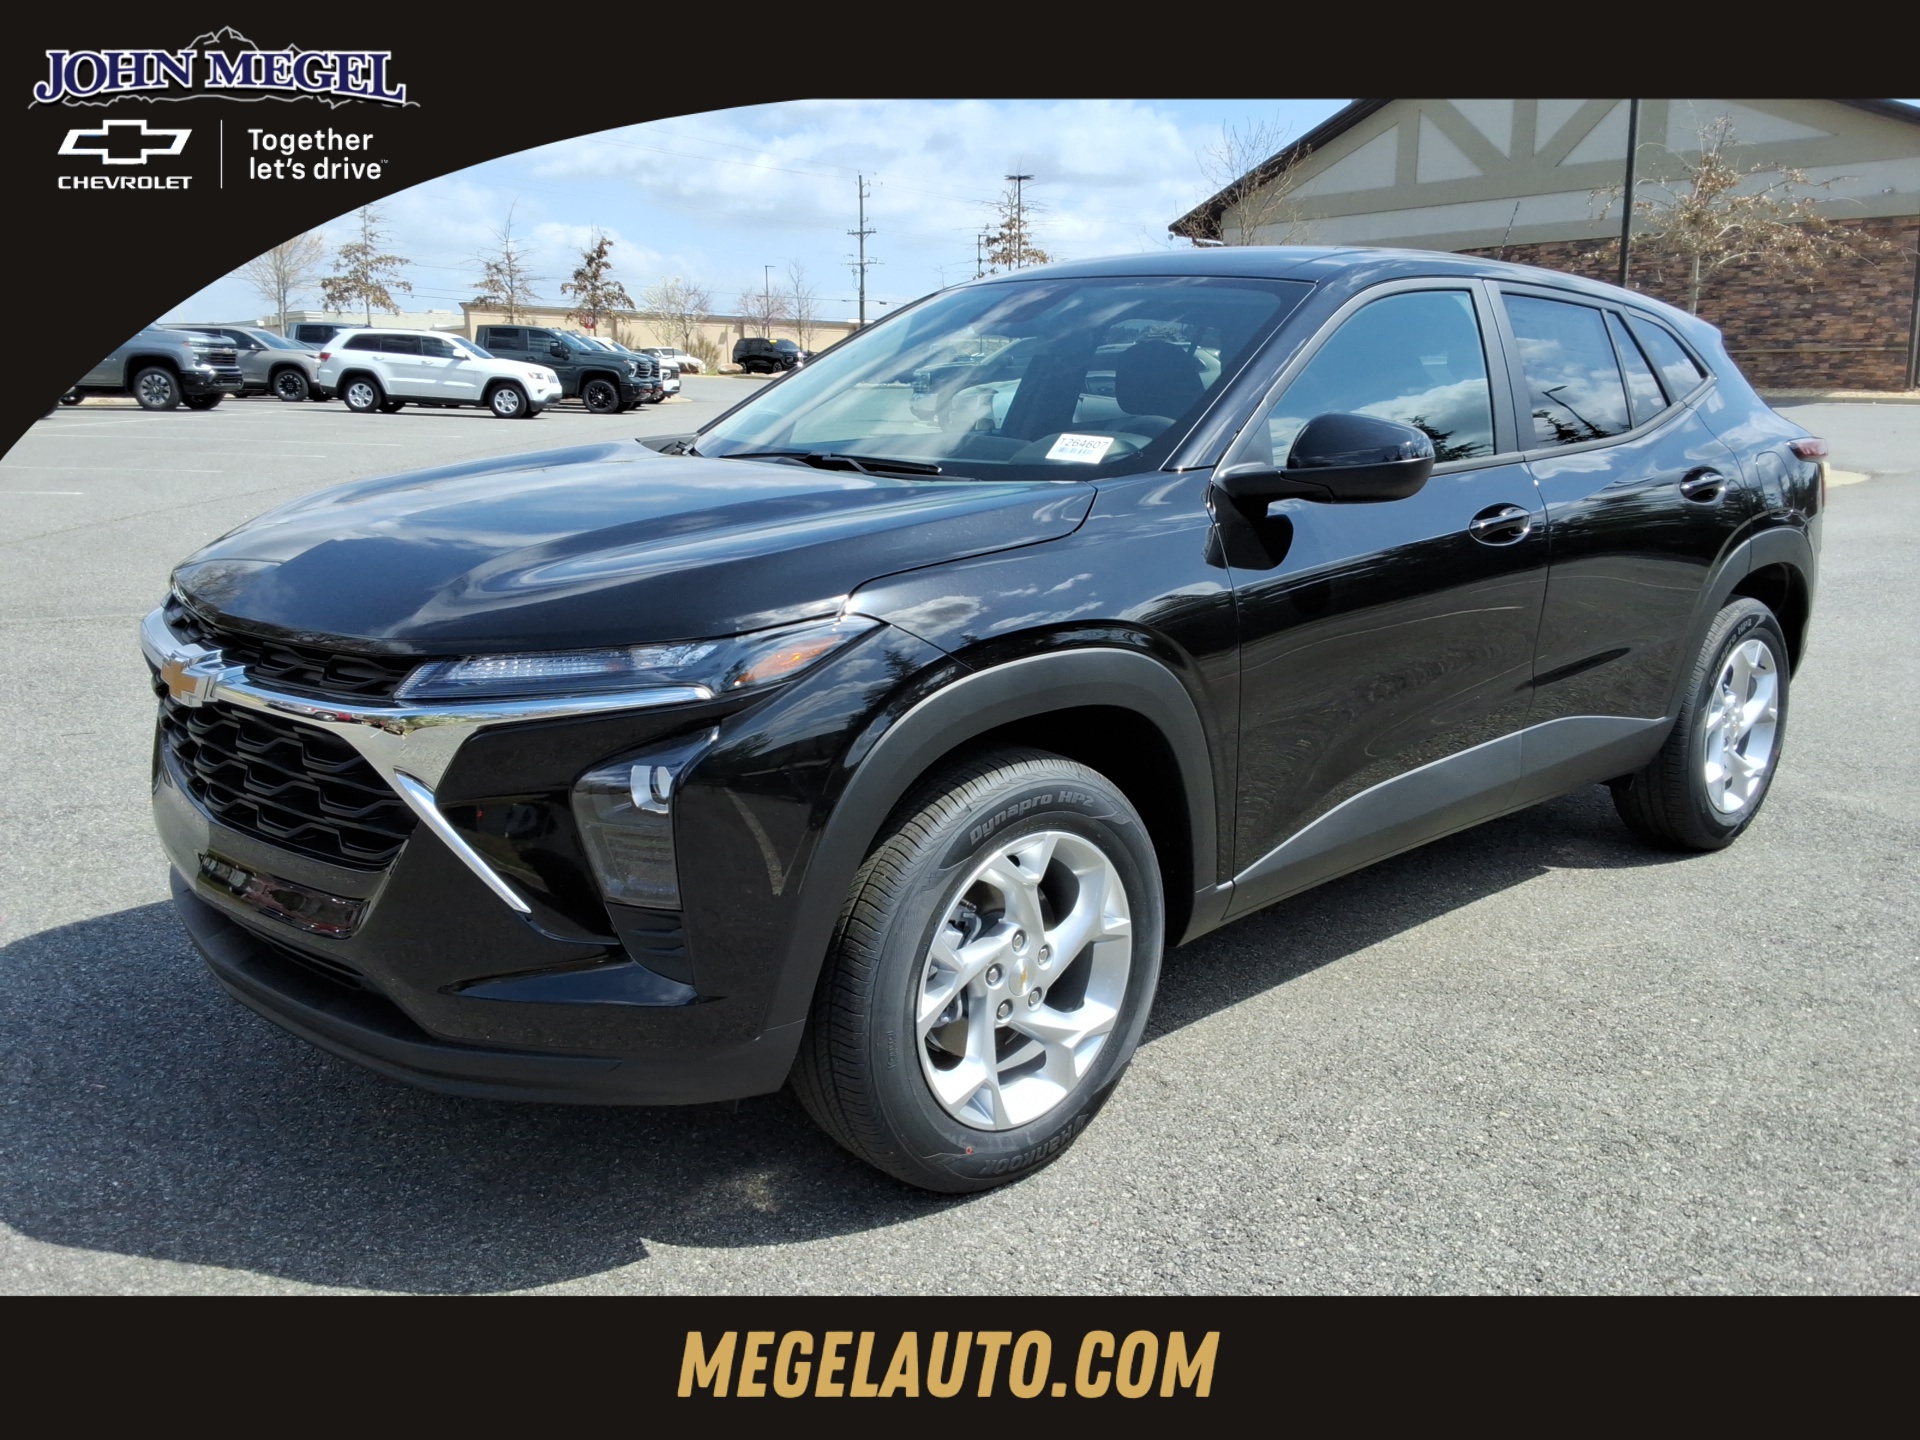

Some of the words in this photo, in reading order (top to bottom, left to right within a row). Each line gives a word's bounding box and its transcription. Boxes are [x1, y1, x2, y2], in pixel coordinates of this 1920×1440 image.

[1059, 437, 1108, 449] T264607
[969, 794, 1053, 846] Dynapro
[1058, 790, 1095, 808] HP2
